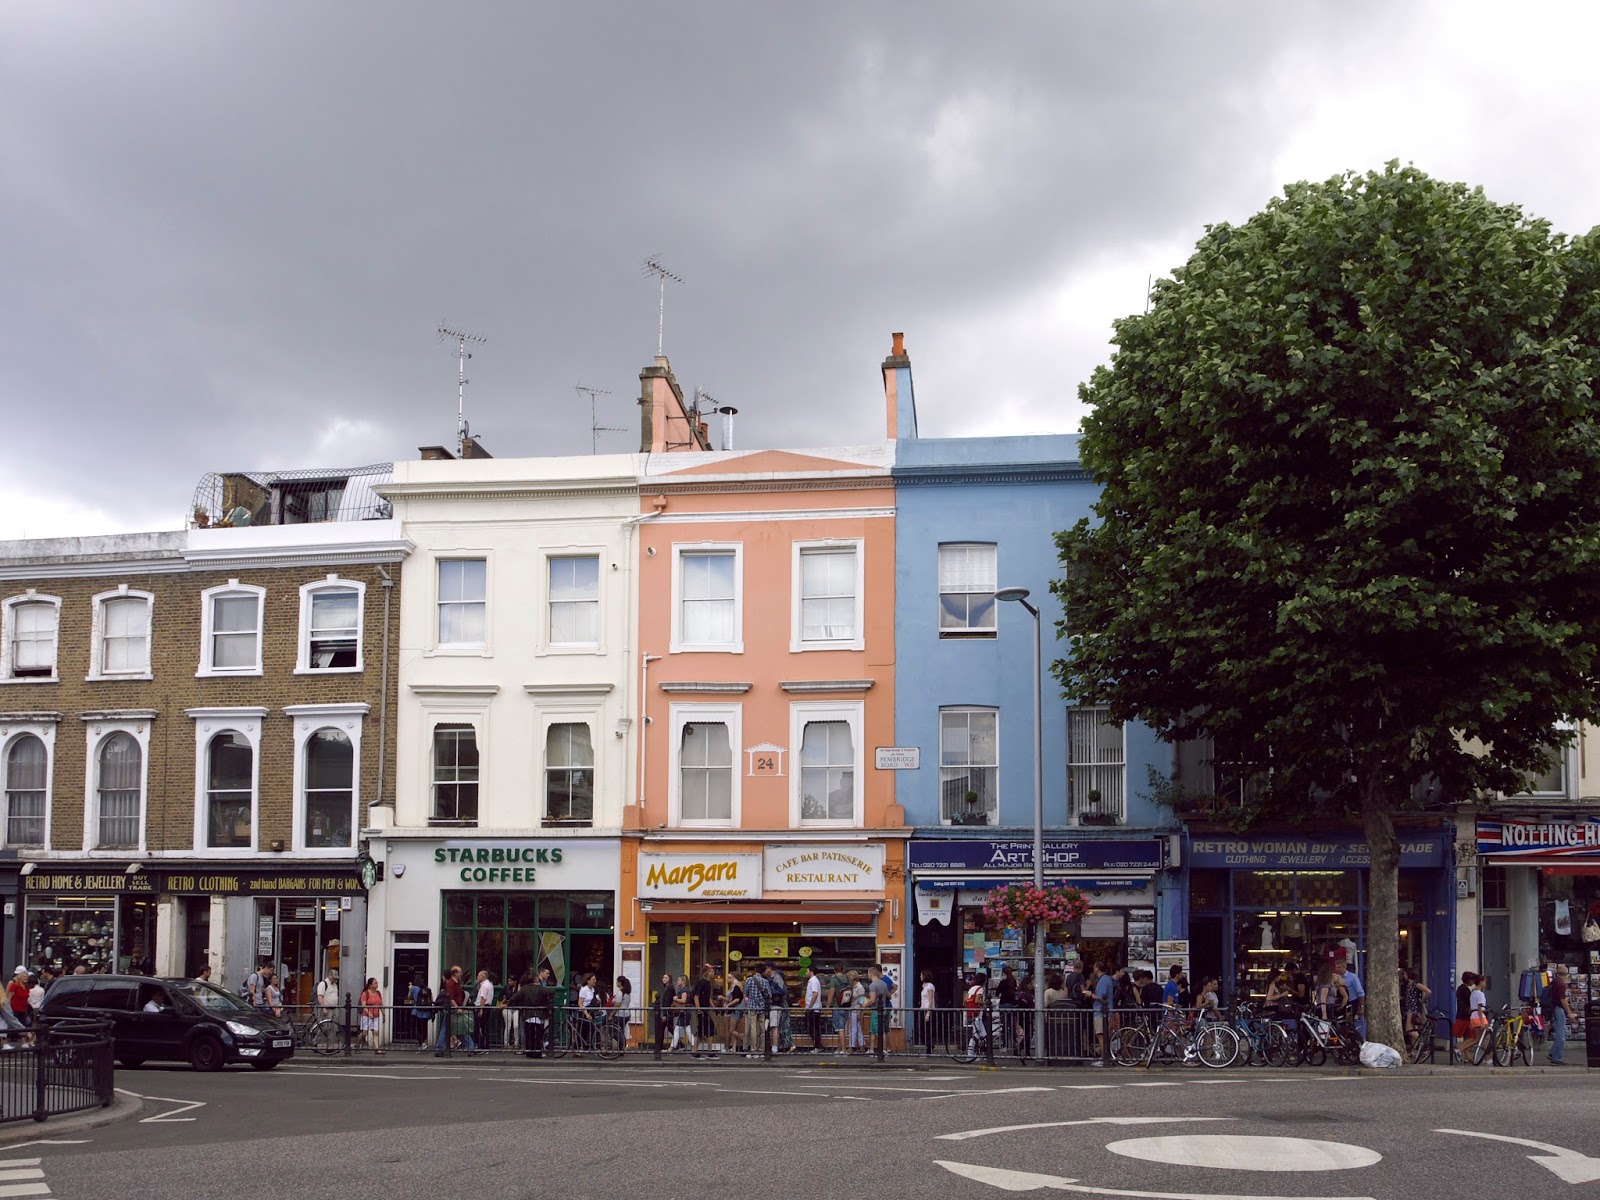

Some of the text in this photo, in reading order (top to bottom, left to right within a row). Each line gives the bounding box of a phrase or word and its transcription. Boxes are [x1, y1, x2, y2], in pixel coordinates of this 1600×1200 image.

[757, 758, 774, 770] 24
[1502, 824, 1578, 846] NOTTING
[1193, 841, 1249, 854] RETRO
[1251, 842, 1307, 854] WOMAN
[1311, 844, 1338, 854] BUY
[1399, 843, 1434, 853] RADE
[434, 848, 563, 863] STARBUCKS
[989, 849, 1029, 863] ART
[1225, 855, 1267, 864] CLOTHING
[1277, 855, 1327, 864] JEWELLERY
[775, 851, 873, 875] CAFE BAR PATISSERIE
[460, 867, 537, 882] COFFEE
[786, 873, 859, 883] RESTAURANT
[25, 875, 126, 889] RETRO HOME & JEWELLERY
[167, 876, 195, 890] RETRO
[199, 876, 239, 891] CLOTHING
[249, 878, 260, 889] 2nd
[261, 877, 277, 889] hand
[278, 877, 306, 889] BARGAINS
[308, 877, 321, 889] FOR
[322, 877, 336, 889] MEN
